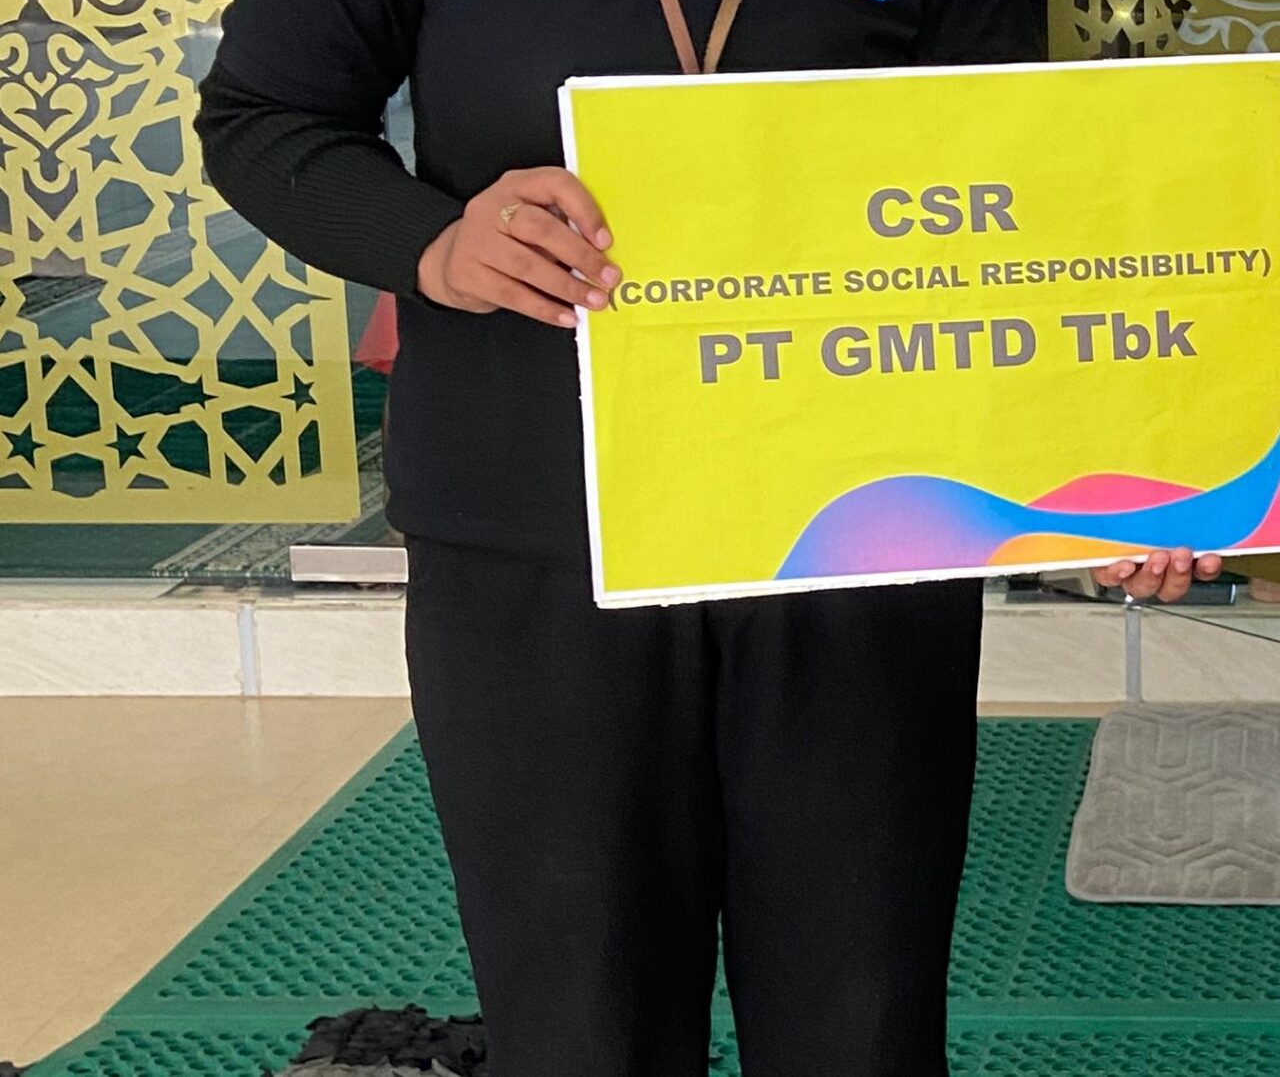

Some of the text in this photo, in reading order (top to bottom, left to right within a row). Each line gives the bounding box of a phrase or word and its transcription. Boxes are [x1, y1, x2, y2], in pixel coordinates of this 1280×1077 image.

[867, 183, 1019, 238] CSR
[608, 248, 1272, 311] (CORPORATE SOCIAL RESPONSIBILITY)
[699, 310, 1198, 384] PT GMTD Tbk
